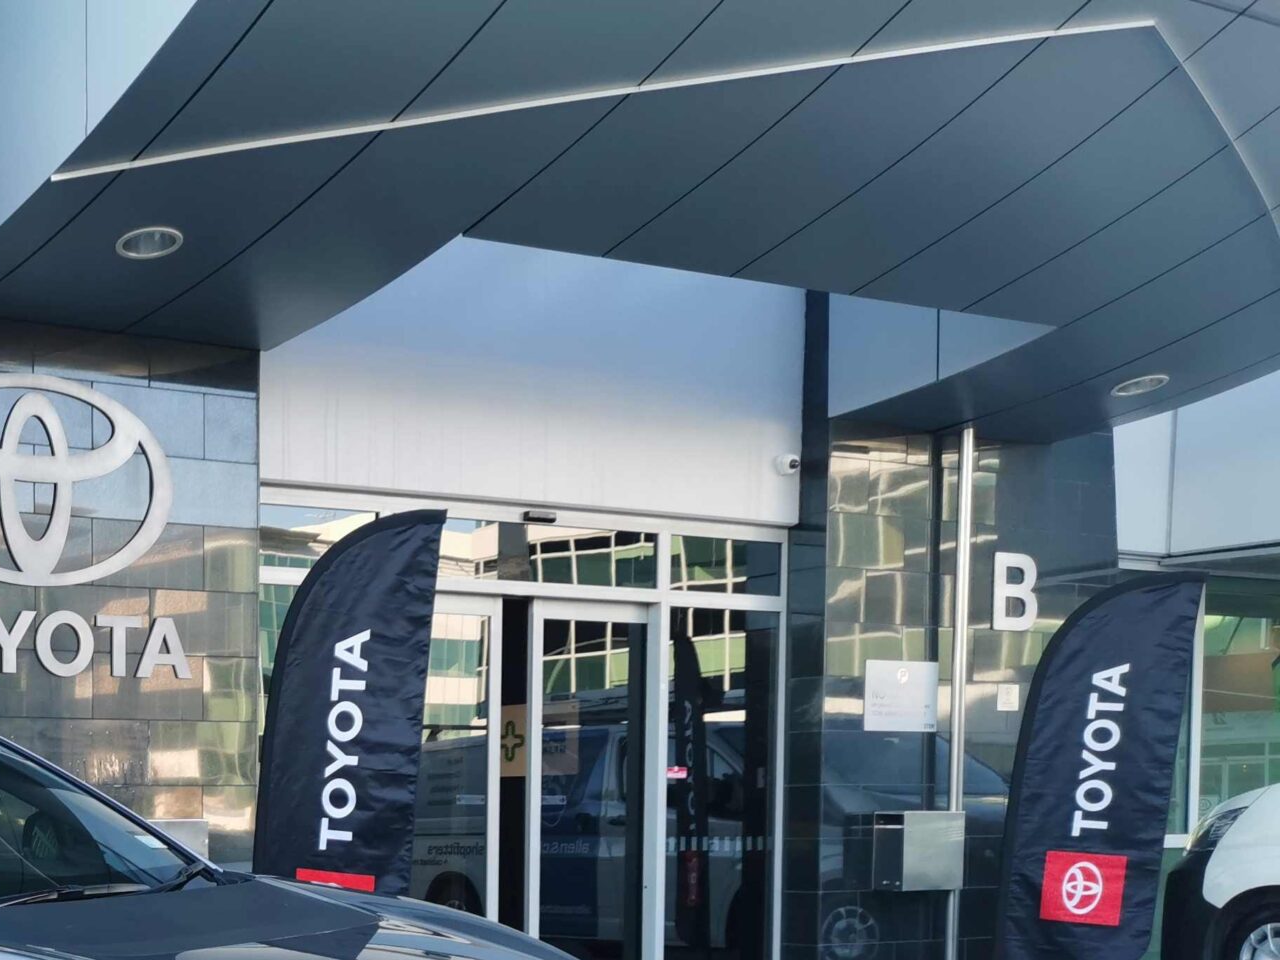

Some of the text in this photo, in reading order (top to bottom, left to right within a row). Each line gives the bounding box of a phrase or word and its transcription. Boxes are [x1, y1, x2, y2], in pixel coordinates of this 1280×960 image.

[992, 551, 1038, 631] B
[319, 628, 371, 851] TOYOTA
[1071, 661, 1132, 837] TOYOTA
